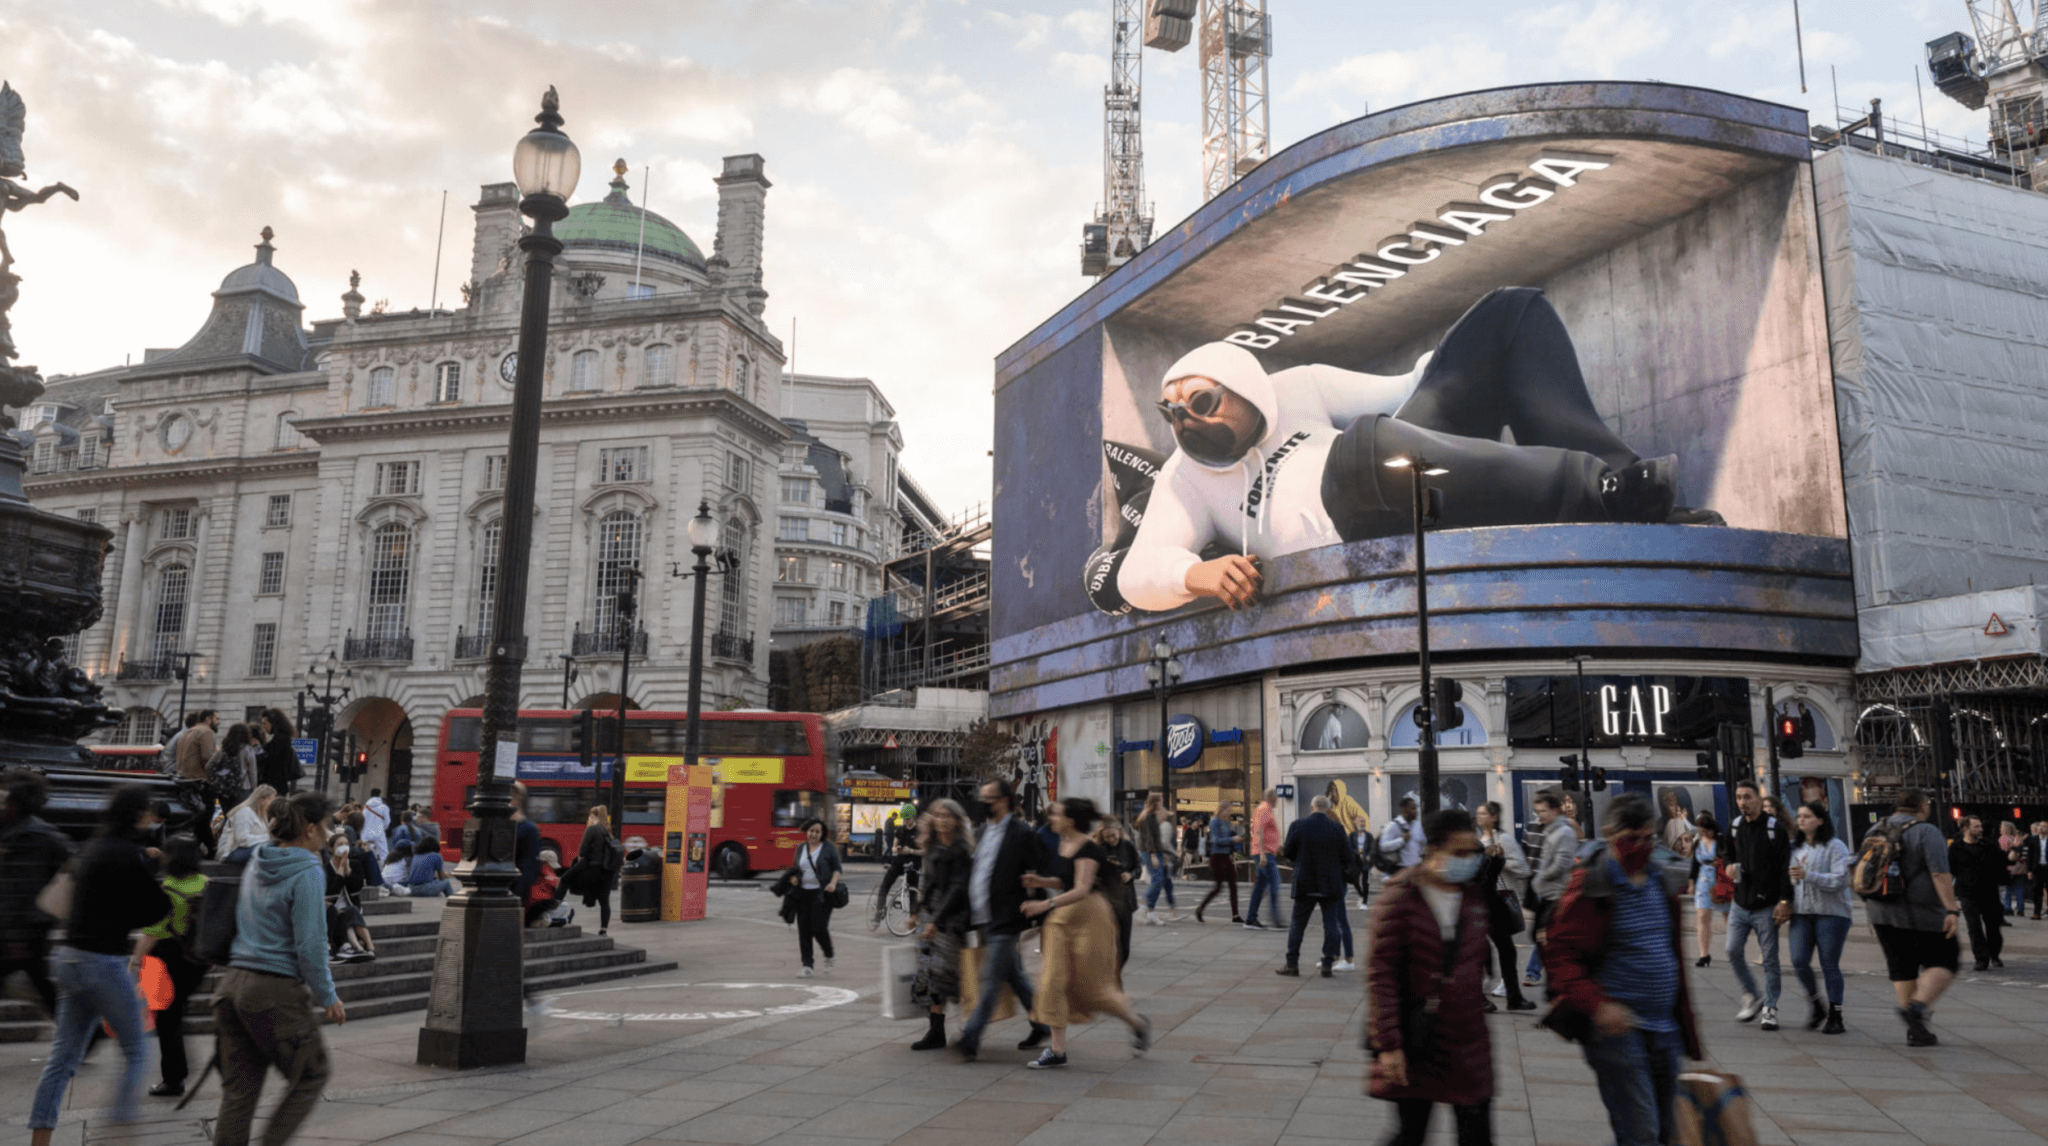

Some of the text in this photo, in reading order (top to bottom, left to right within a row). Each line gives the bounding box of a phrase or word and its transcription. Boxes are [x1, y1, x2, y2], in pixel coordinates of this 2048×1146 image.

[1224, 151, 1616, 350] BALENCIAGA
[1600, 684, 1670, 736] GAP
[1167, 722, 1195, 759] Boots
